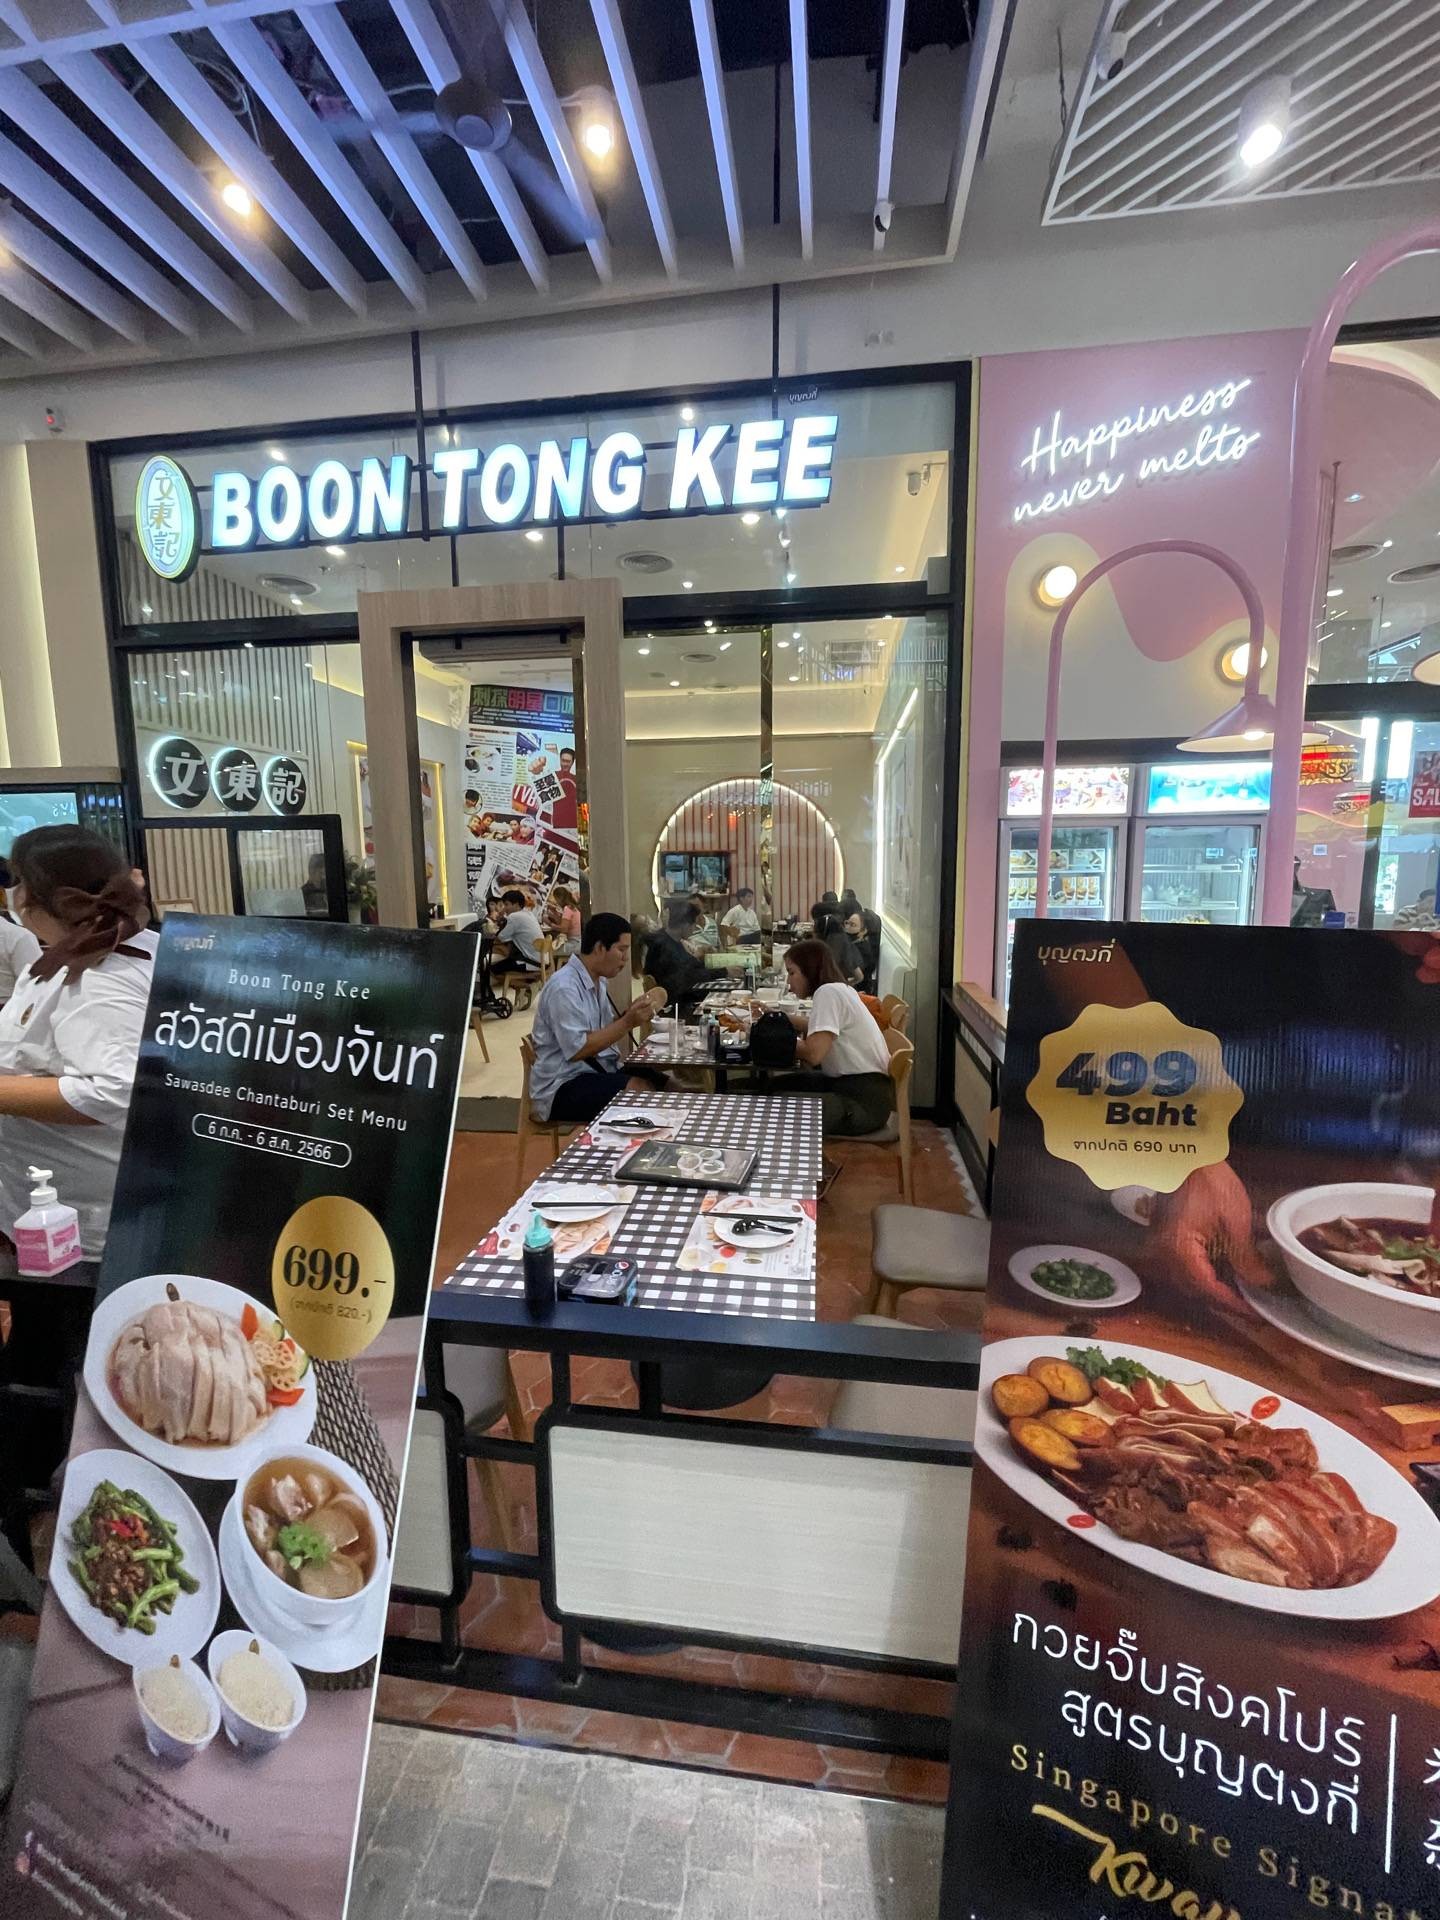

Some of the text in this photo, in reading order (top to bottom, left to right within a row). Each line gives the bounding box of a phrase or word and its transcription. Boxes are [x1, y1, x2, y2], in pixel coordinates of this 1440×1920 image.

[1021, 379, 1252, 476] Happiness
[212, 415, 838, 548] BOON TONG KEE
[1014, 423, 1260, 521] never melts
[163, 751, 302, 806] 文東記
[1038, 938, 1116, 966] บุญตงกี่
[229, 968, 370, 1000] Boon Tong Kee
[155, 1002, 445, 1089] สวัสดีเมืองจันท์
[1056, 1050, 1198, 1097] 499
[164, 1073, 408, 1131] Sawasdee Chantaburi Set Menu
[1105, 1101, 1198, 1126] Baht
[208, 1121, 216, 1135] 6
[256, 1131, 265, 1145] 6
[297, 1140, 332, 1160] 2566
[1073, 1138, 1197, 1154] จากปกติ 690 บาท
[283, 1245, 387, 1298] 699.-
[1013, 1613, 1365, 1767] กวยจั๊บสิงคโปร์
[1061, 1690, 1359, 1834] สูตรบุญตงกี่
[1011, 1744, 1232, 1857] Singapore
